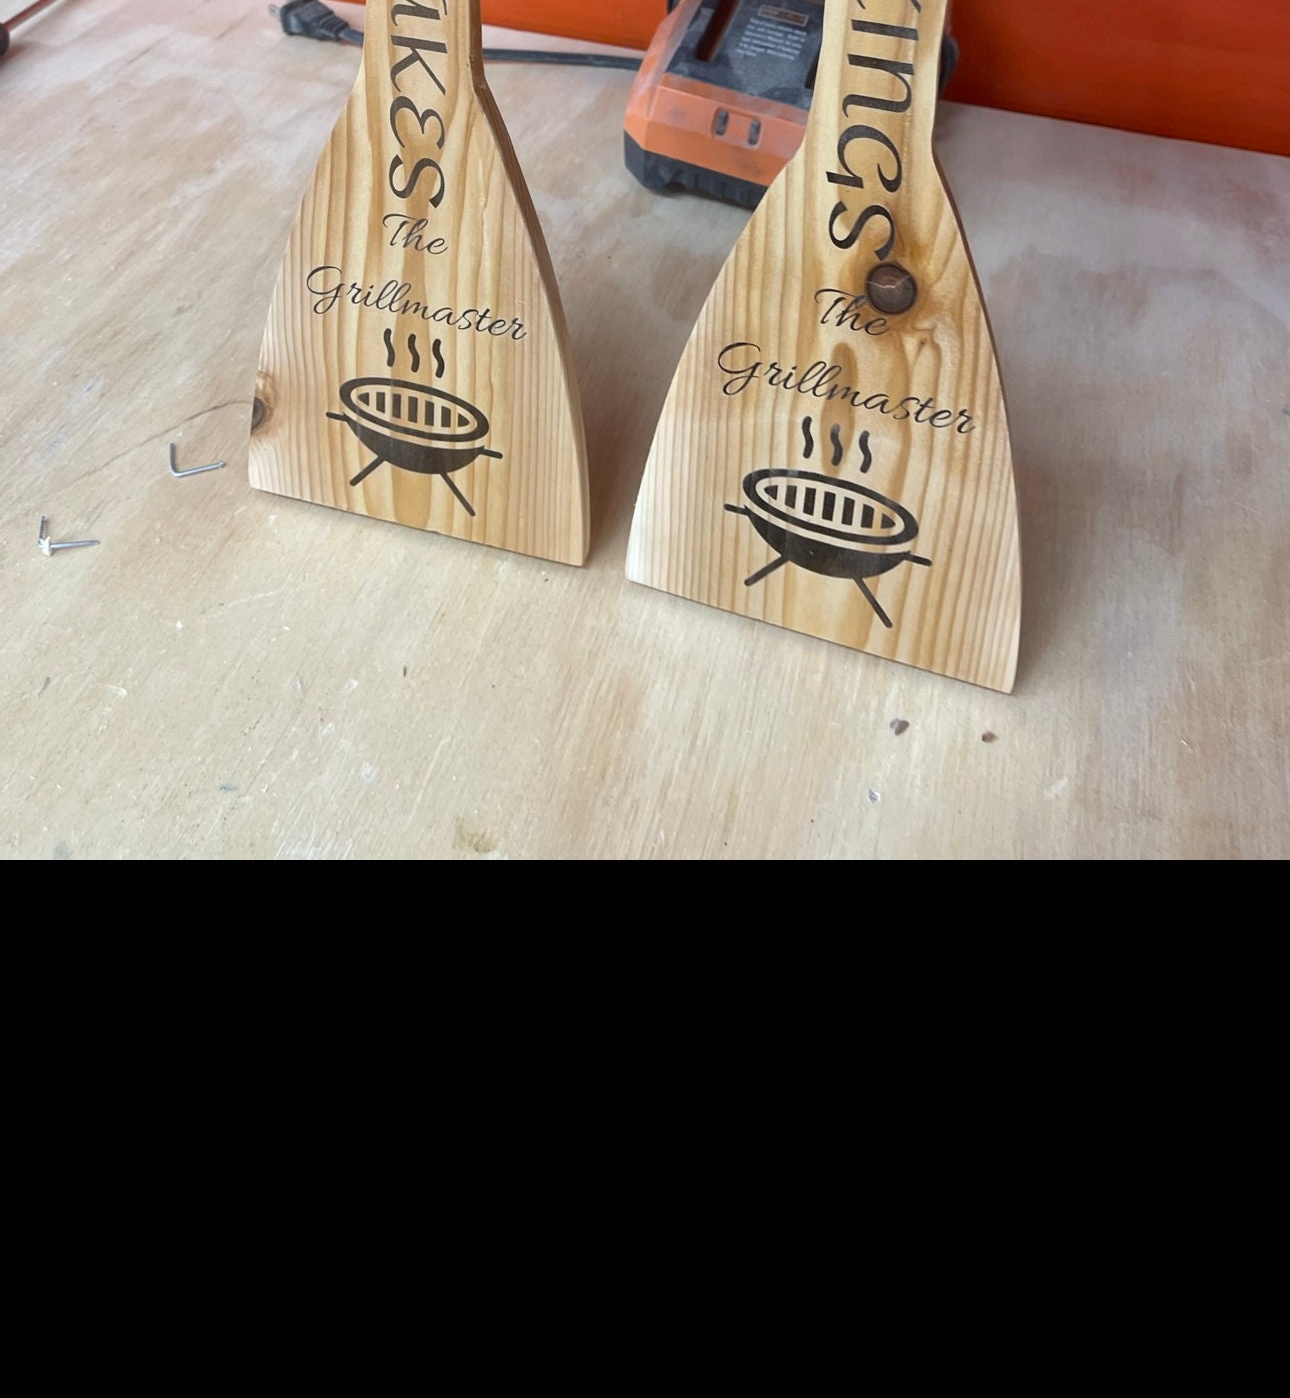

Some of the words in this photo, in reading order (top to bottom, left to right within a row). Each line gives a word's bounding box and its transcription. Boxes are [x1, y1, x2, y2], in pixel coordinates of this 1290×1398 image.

[382, 213, 448, 256] The
[305, 265, 528, 341] Grillmaster
[814, 288, 890, 337] The
[717, 341, 977, 435] Grillmaster
